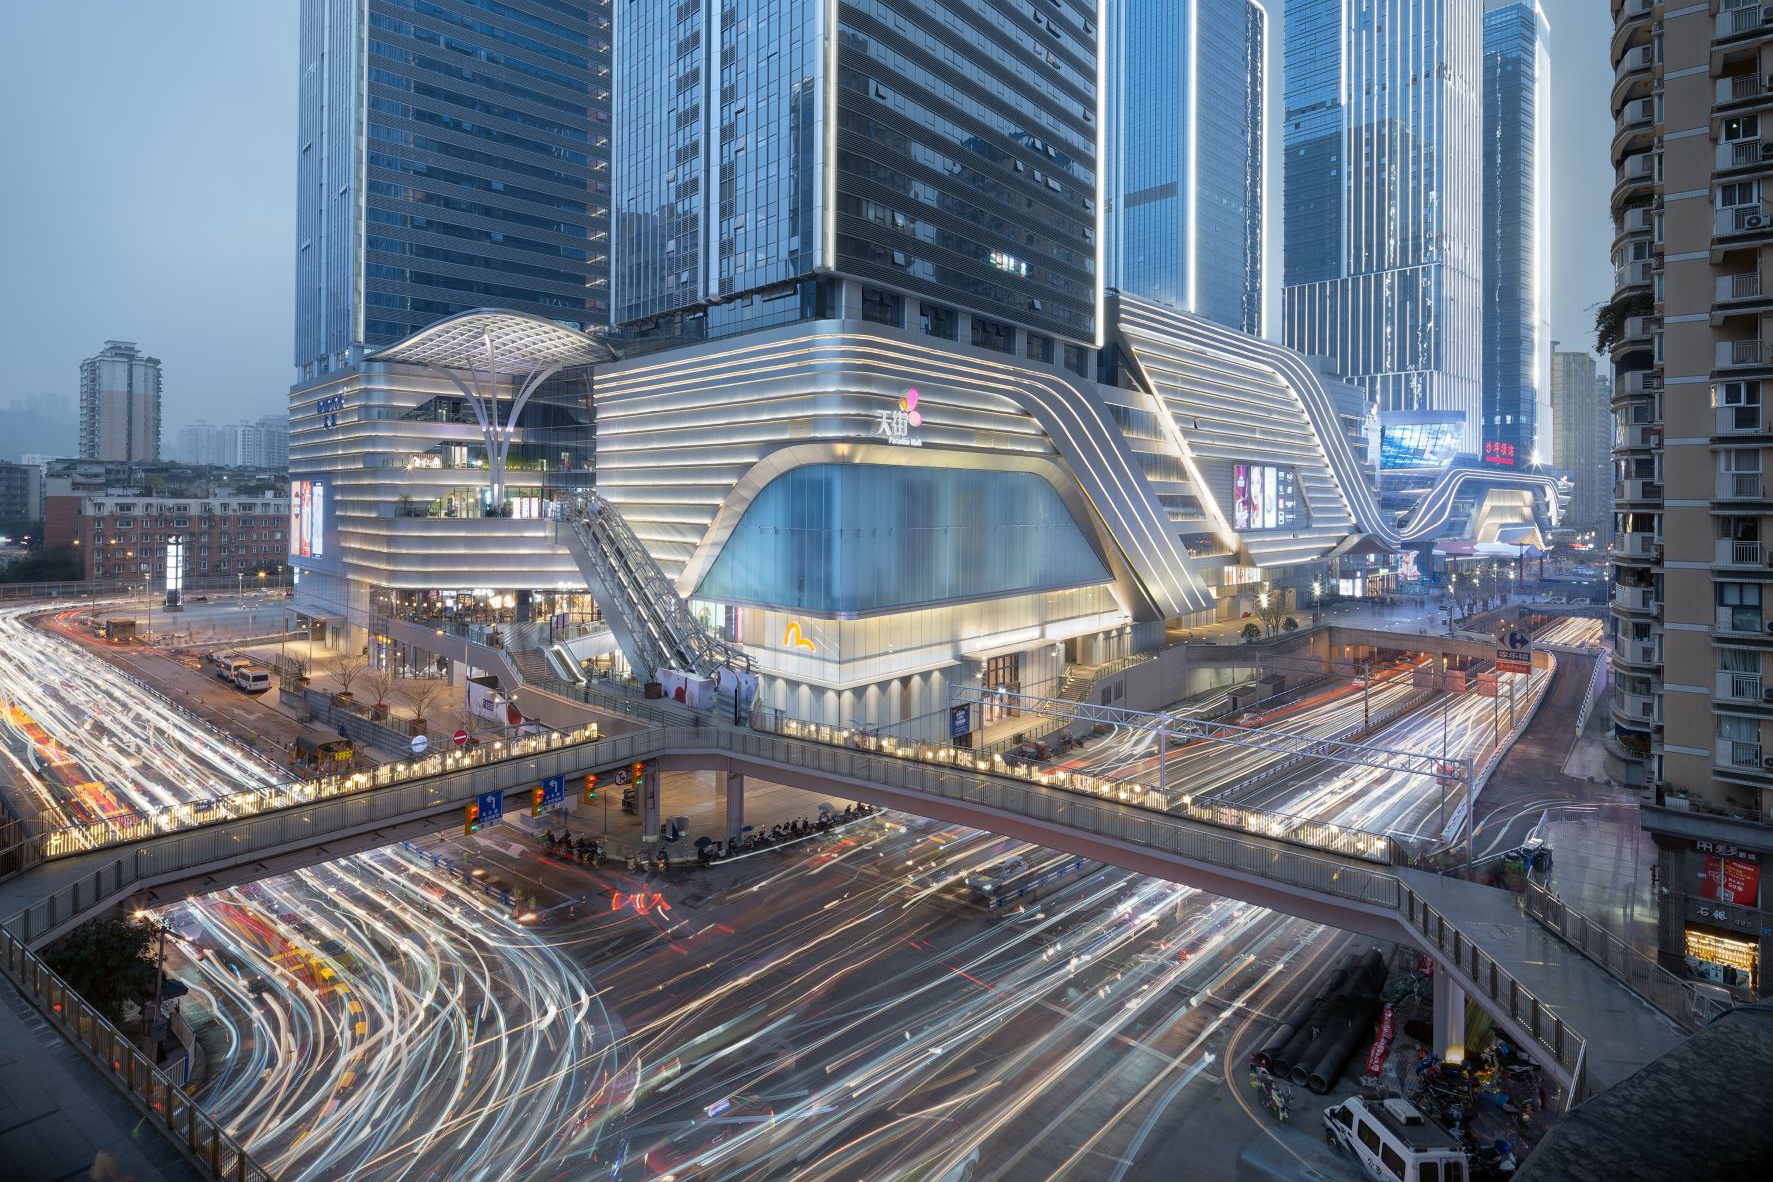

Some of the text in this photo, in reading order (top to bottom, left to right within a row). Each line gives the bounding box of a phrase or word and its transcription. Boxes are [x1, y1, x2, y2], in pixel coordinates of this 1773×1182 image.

[875, 410, 908, 437] 天街
[888, 436, 910, 446] Paradise
[1498, 650, 1529, 661] 家乐福
